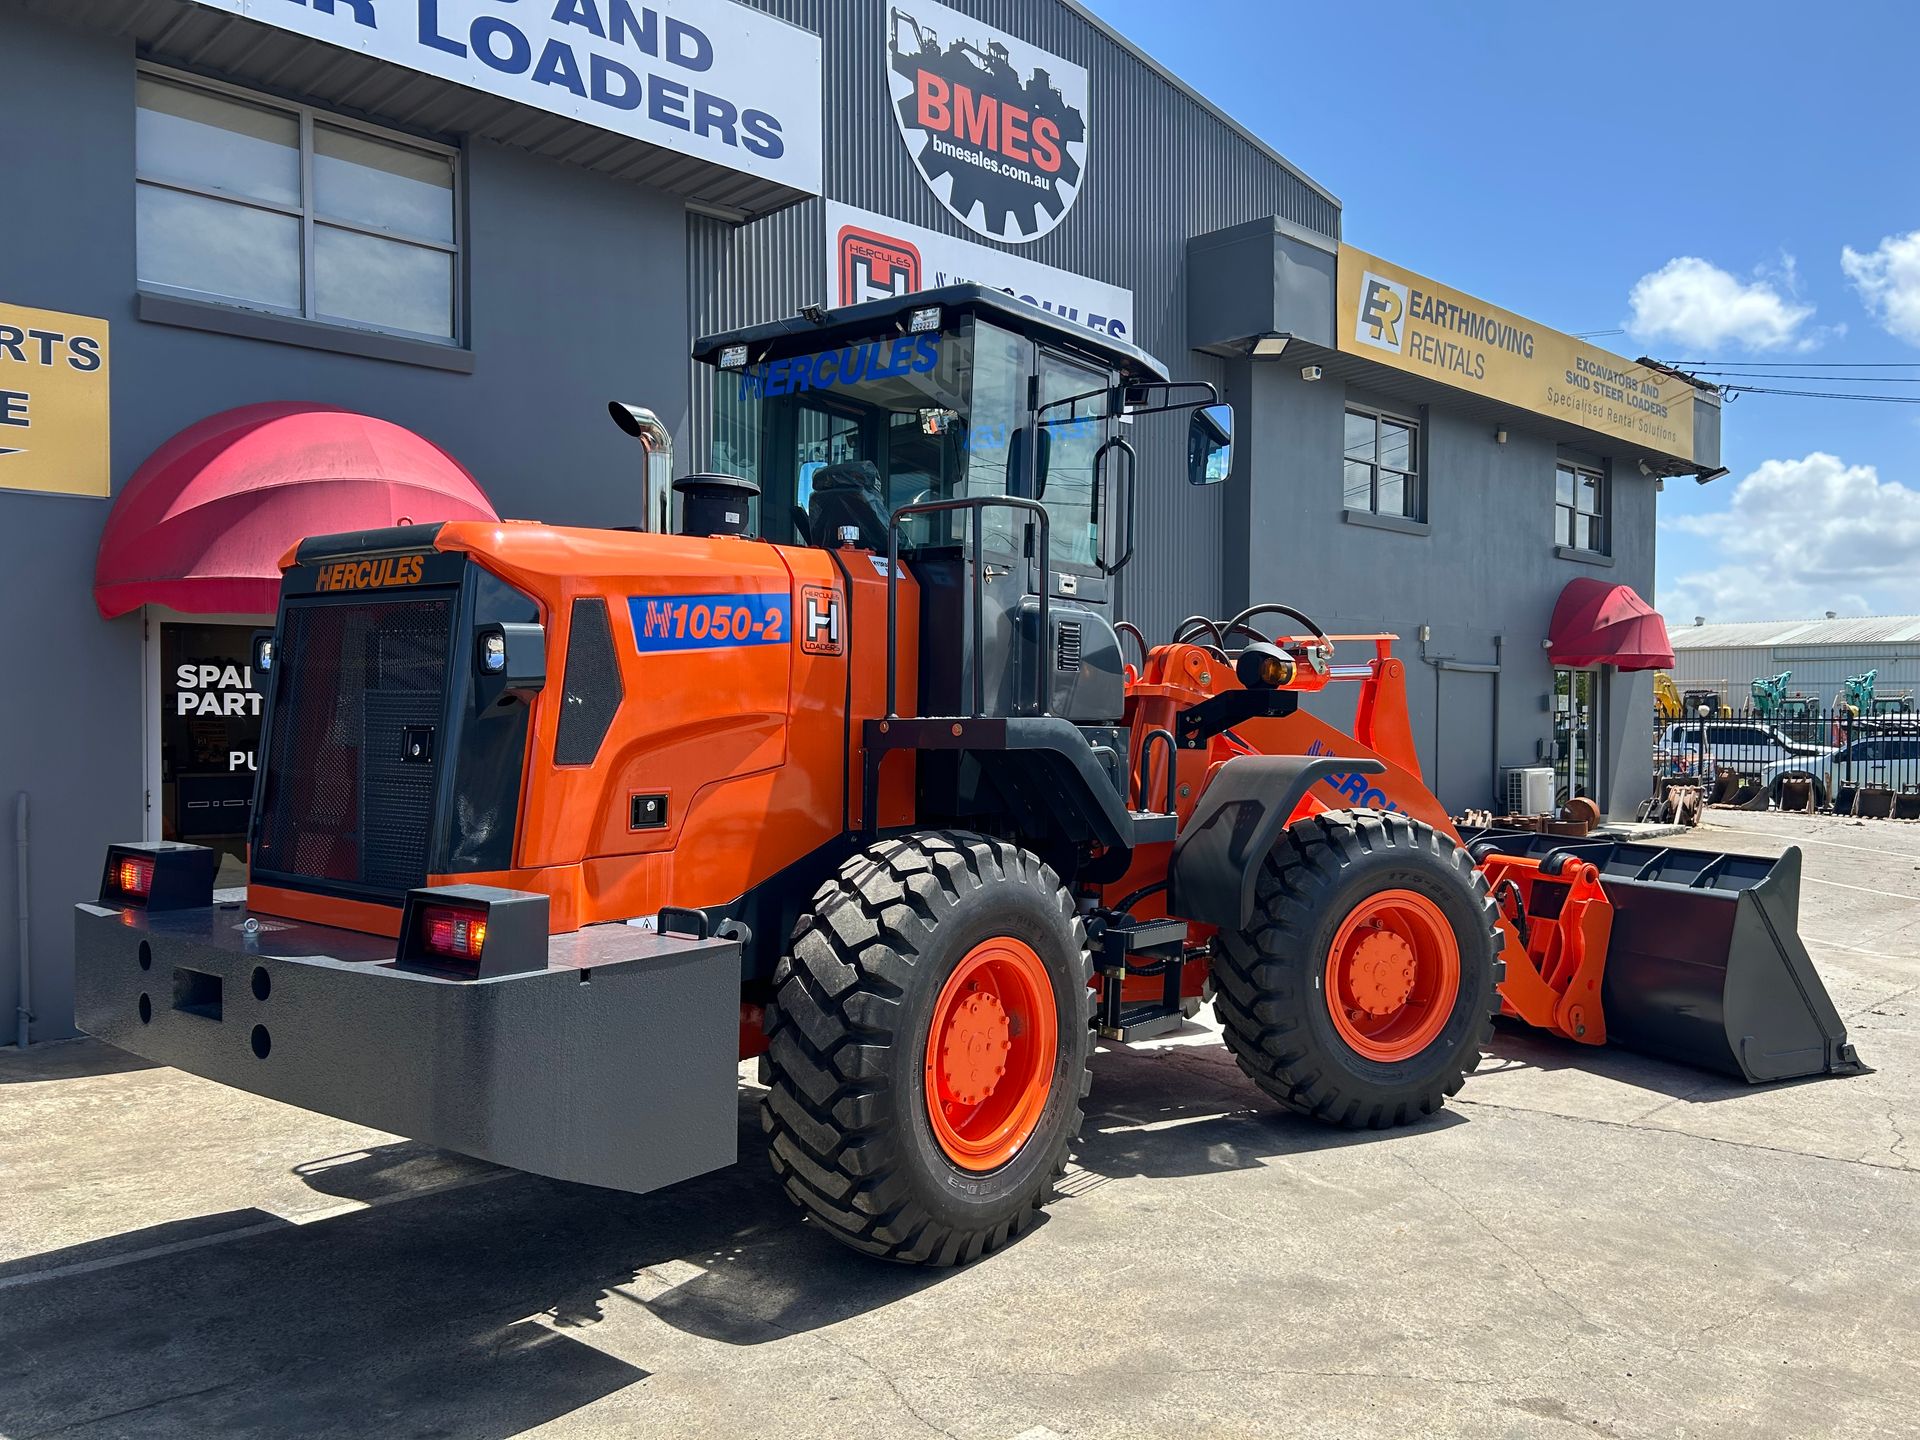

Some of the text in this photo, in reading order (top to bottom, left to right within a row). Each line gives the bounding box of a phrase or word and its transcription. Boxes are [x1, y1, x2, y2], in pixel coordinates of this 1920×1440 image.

[551, 0, 713, 72] AND
[418, 0, 785, 159] LOADERS
[917, 68, 1062, 173] BMES
[933, 134, 1050, 191] bmesales.com.au
[850, 243, 911, 268] HERCULES
[1409, 289, 1534, 359] EARTHMOVING
[739, 332, 940, 400] HERCULES
[1409, 331, 1485, 380] RENTALS
[1576, 356, 1660, 400] EXCAVATORS AND
[1547, 387, 1677, 443] Specialised Rental Solutions
[1565, 370, 1668, 418] SKID STEER LOADERS
[315, 555, 424, 592] HERCULES
[804, 641, 841, 652] LOADERS
